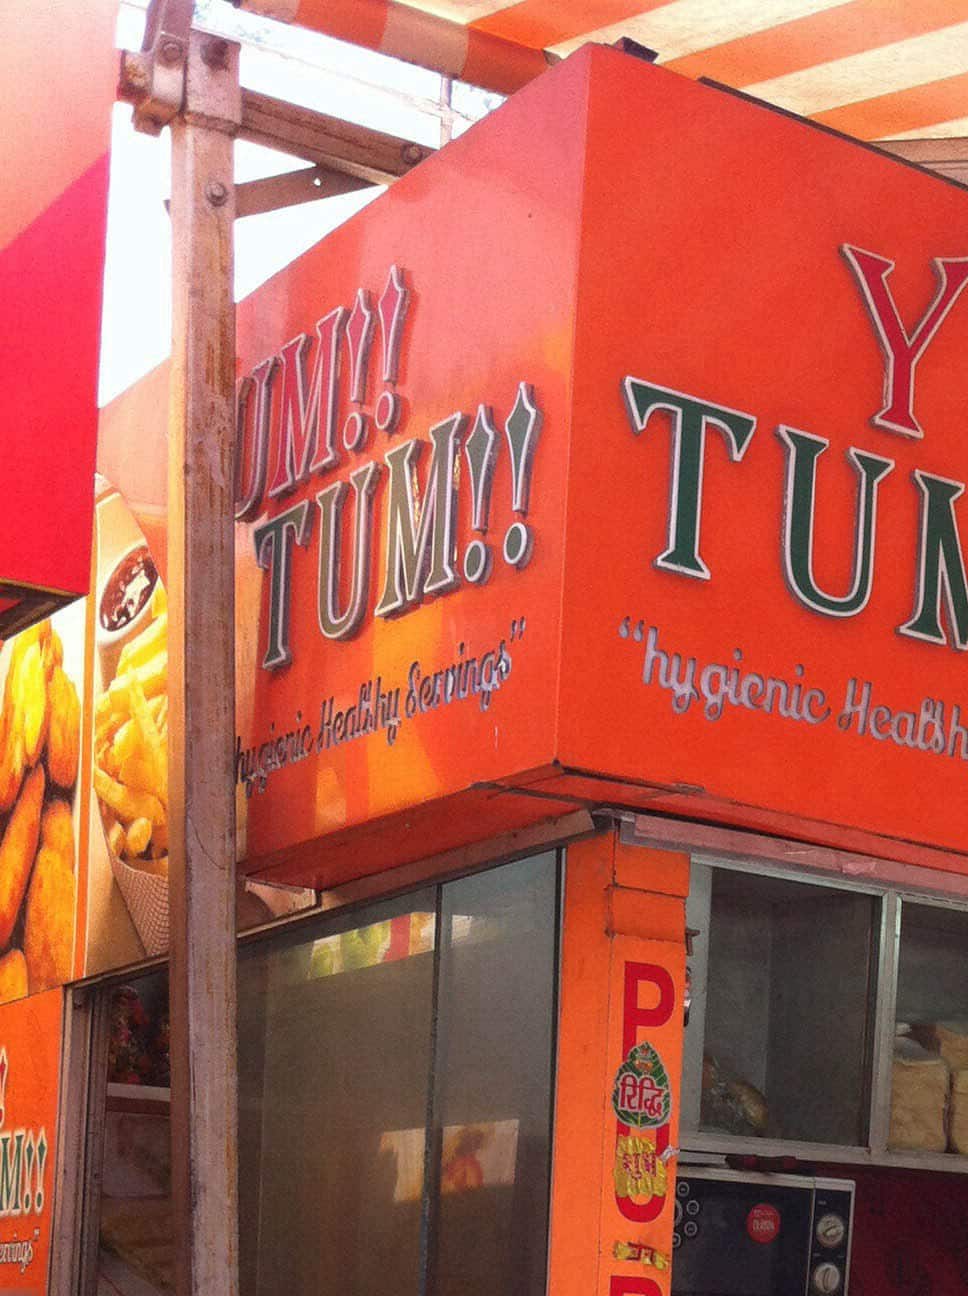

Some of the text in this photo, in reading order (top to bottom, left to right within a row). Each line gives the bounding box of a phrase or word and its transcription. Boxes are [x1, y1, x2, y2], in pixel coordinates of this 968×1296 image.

[235, 264, 410, 521] UM!!
[254, 381, 542, 672] TUM!!
[314, 675, 402, 747] Healthy
[0, 1126, 48, 1217] M!!
